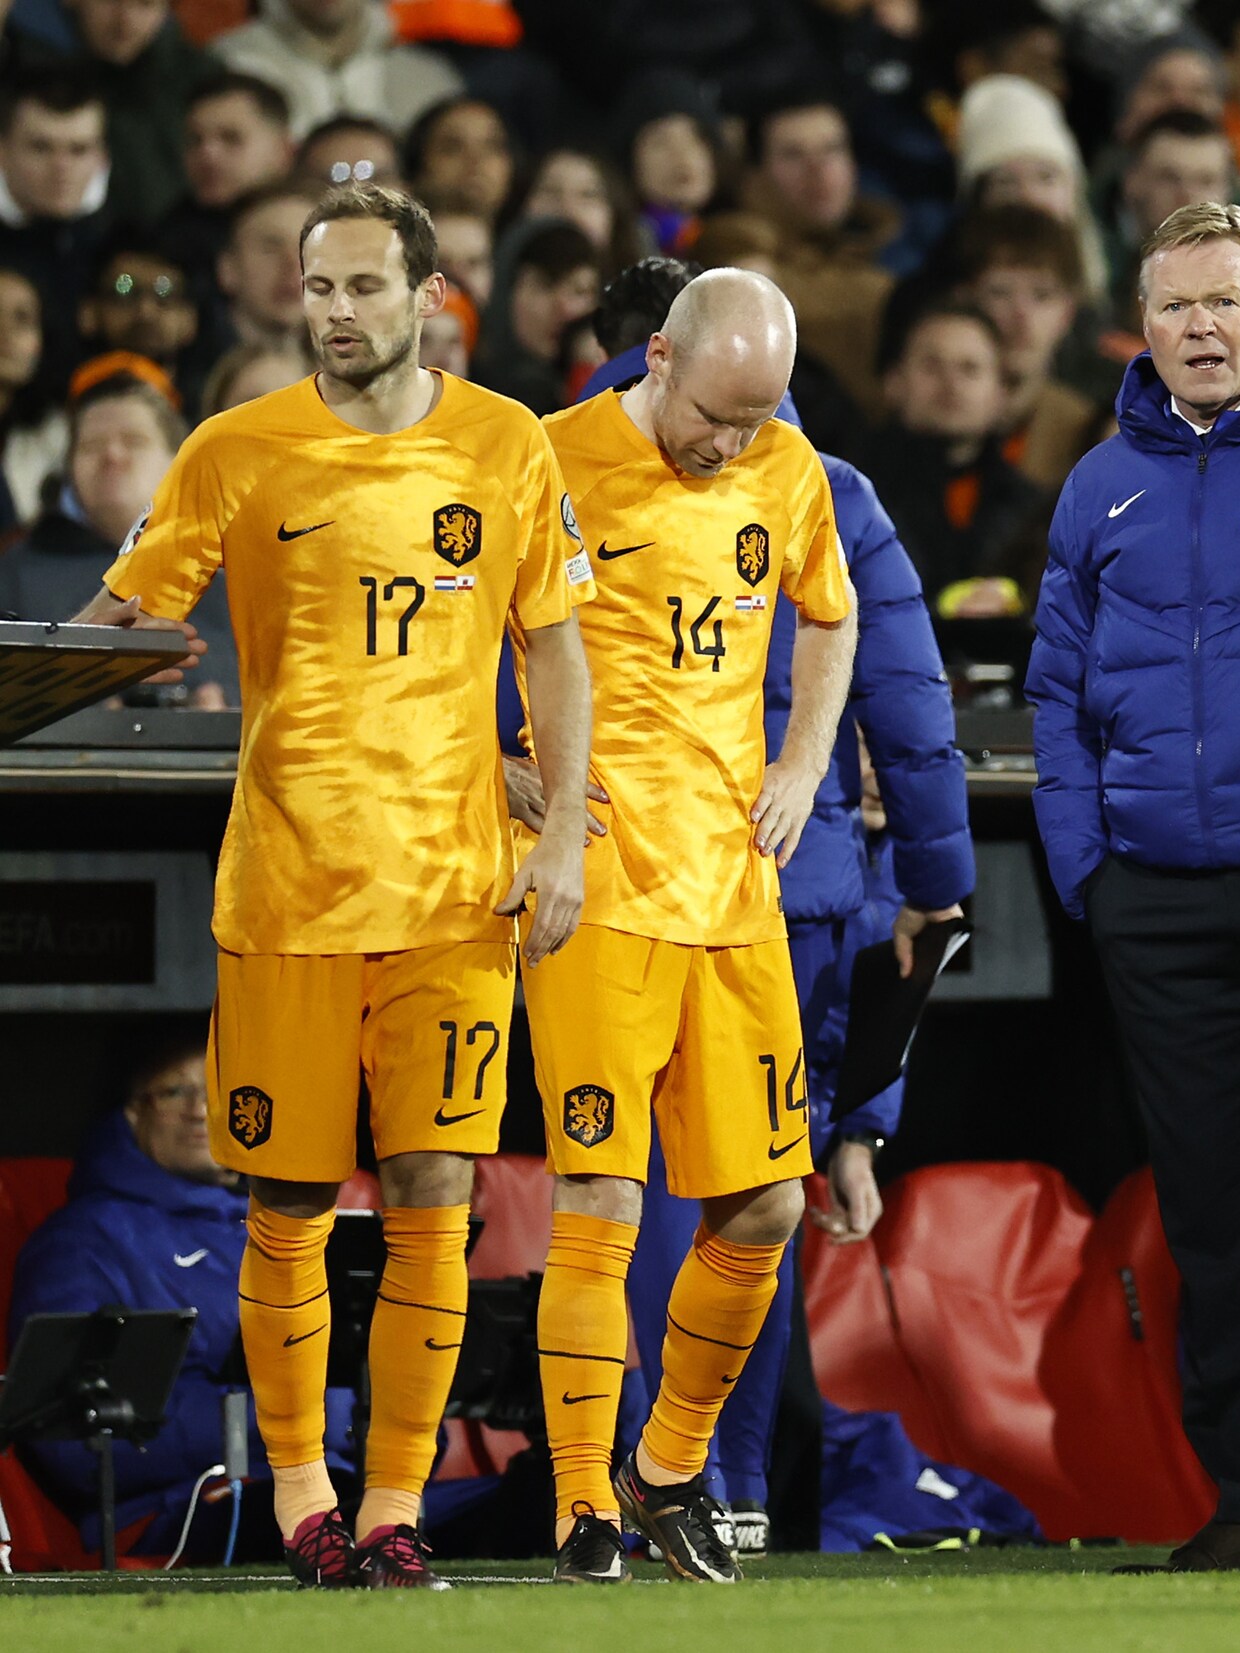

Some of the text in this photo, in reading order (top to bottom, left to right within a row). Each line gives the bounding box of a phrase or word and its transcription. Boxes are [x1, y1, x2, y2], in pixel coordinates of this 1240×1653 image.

[359, 576, 426, 656] 17
[666, 595, 727, 673] 14
[439, 1020, 501, 1101] 17
[758, 1046, 808, 1132] 14
